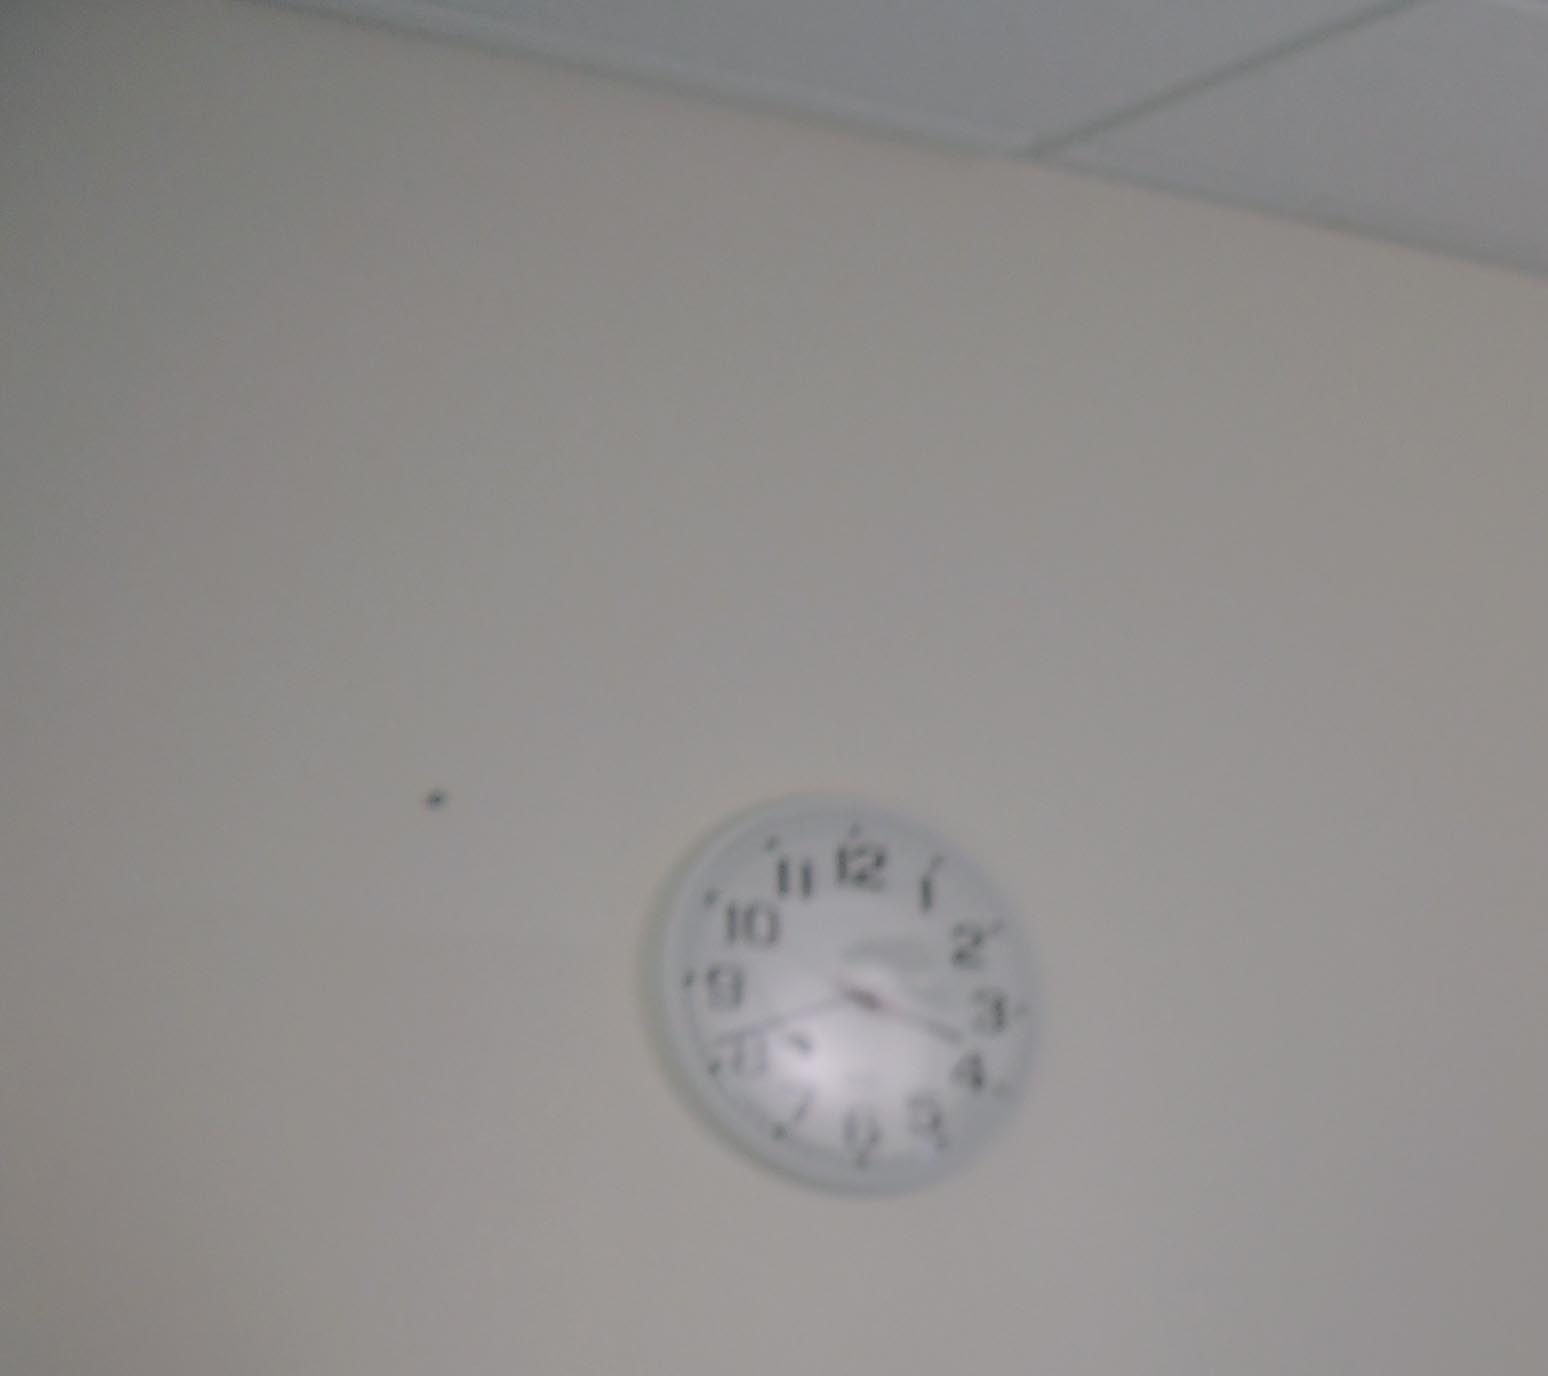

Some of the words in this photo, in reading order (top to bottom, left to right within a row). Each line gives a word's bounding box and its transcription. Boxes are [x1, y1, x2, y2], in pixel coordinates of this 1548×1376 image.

[777, 854, 814, 898] 11
[836, 843, 886, 891] 12
[919, 875, 934, 913] 1
[725, 901, 780, 946] 10
[951, 920, 985, 970] 2
[706, 964, 744, 1009] 9
[971, 988, 1007, 1033] 3
[951, 1051, 986, 1091] 4
